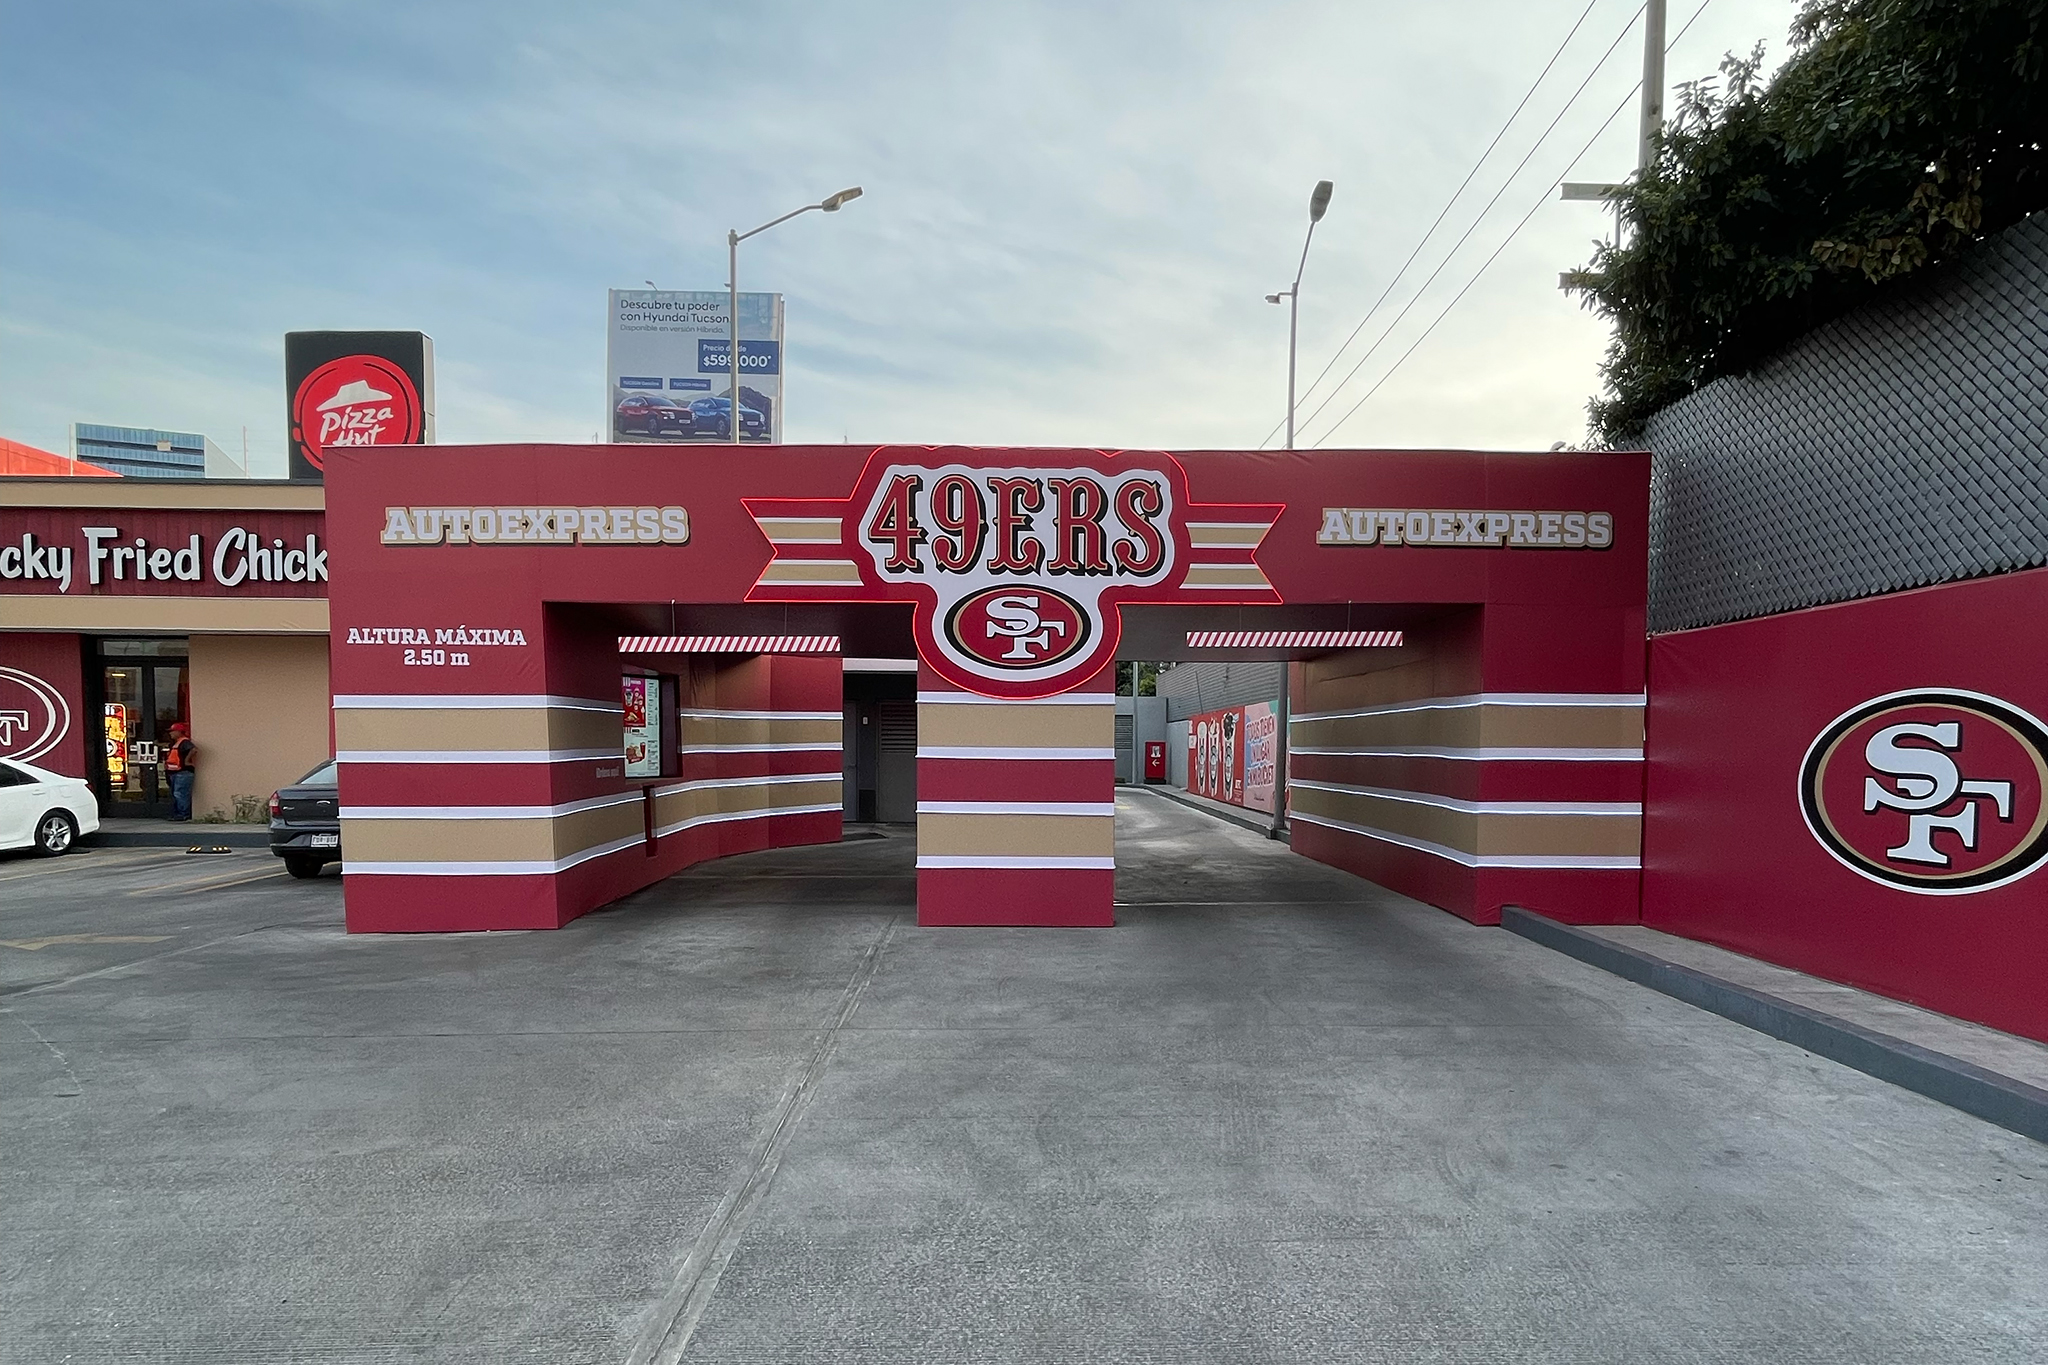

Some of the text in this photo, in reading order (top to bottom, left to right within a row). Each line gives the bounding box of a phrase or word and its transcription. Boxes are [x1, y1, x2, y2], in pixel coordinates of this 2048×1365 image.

[620, 299, 720, 314] Descubre tu poder
[620, 313, 641, 322] con
[643, 312, 689, 323] Hyundai
[620, 324, 658, 333] Disponible
[670, 325, 696, 333] versión
[702, 344, 725, 352] Precio
[319, 406, 394, 443] Pizza
[332, 424, 386, 446] Hut
[381, 506, 689, 544] AUTOEXPRESS
[867, 473, 1167, 577] 49ERS
[1316, 508, 1613, 547] AUTOEXPRESS
[81, 526, 201, 586] Fried
[212, 526, 328, 587] Chick
[346, 625, 528, 647] ALTURA MÁXIMA
[403, 650, 471, 667] 2.50 m
